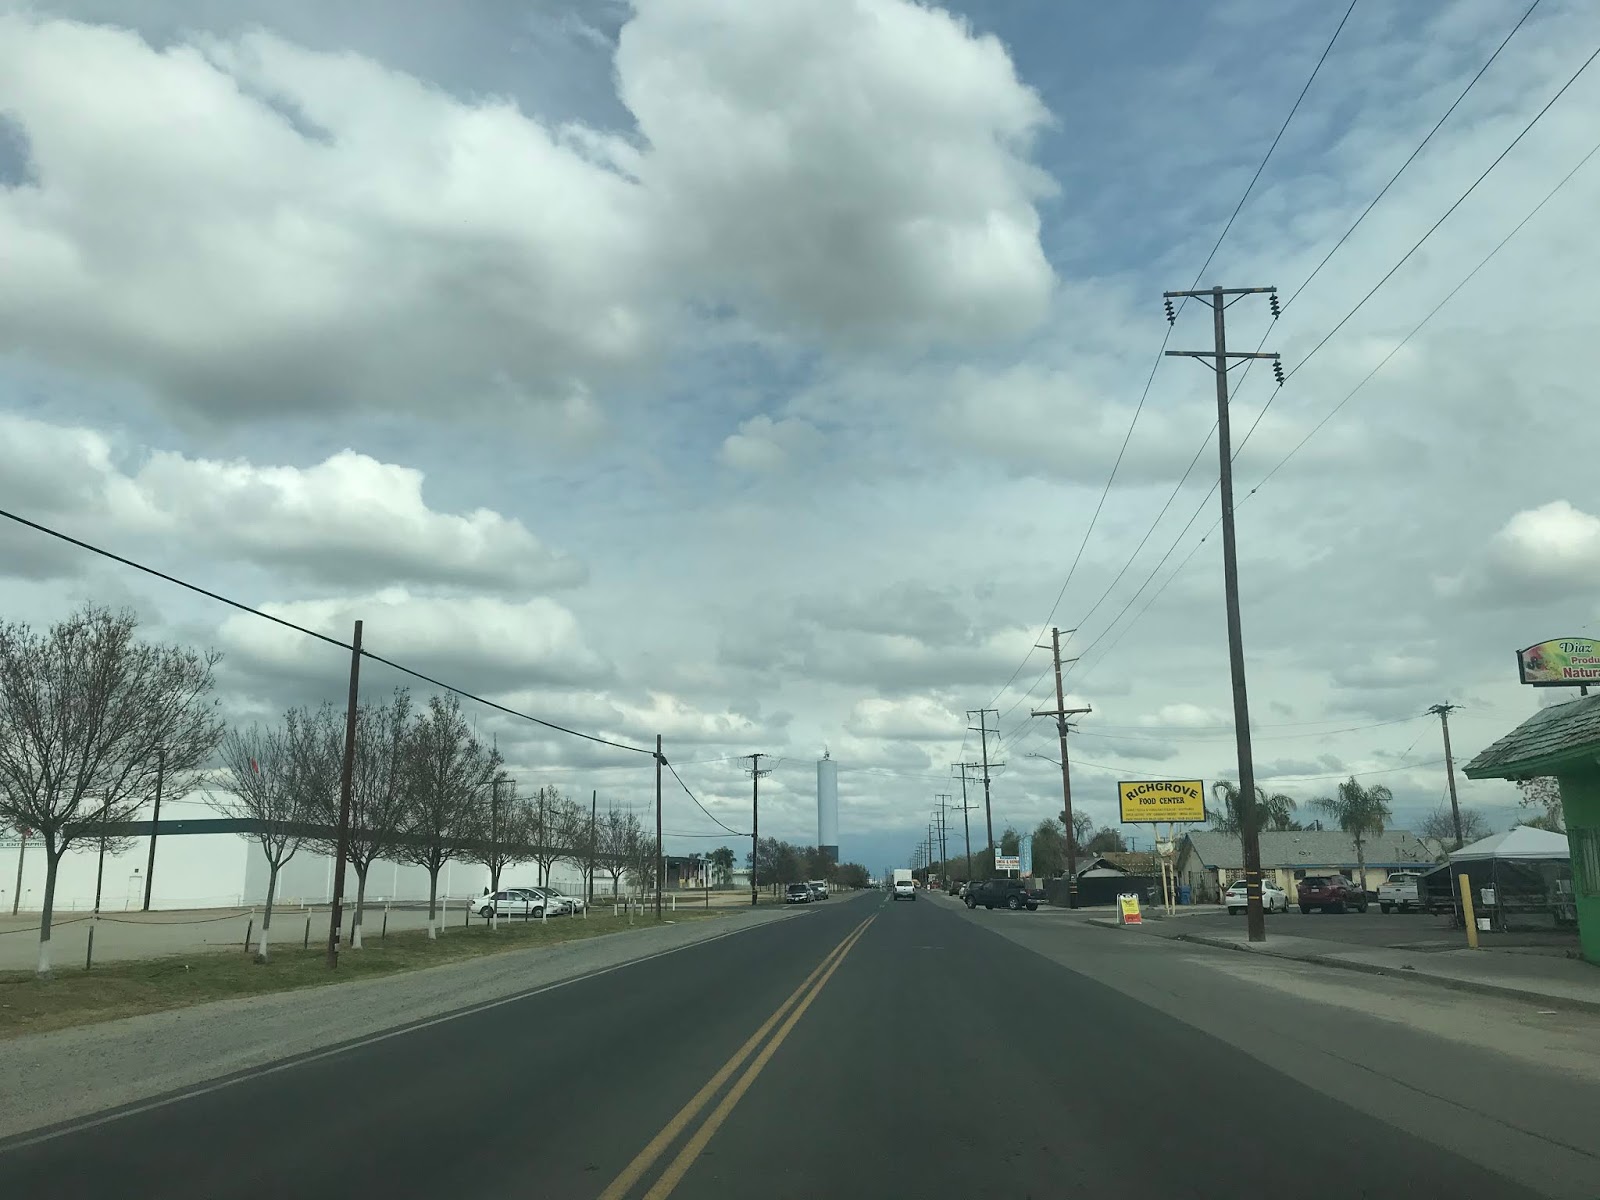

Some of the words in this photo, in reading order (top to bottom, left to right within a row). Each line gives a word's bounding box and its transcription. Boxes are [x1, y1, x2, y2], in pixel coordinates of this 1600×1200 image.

[1560, 642, 1593, 653] Diaz
[1125, 782, 1199, 801] RICHGROVE
[1139, 797, 1157, 805] FOOD
[1159, 796, 1185, 805] CENTER
